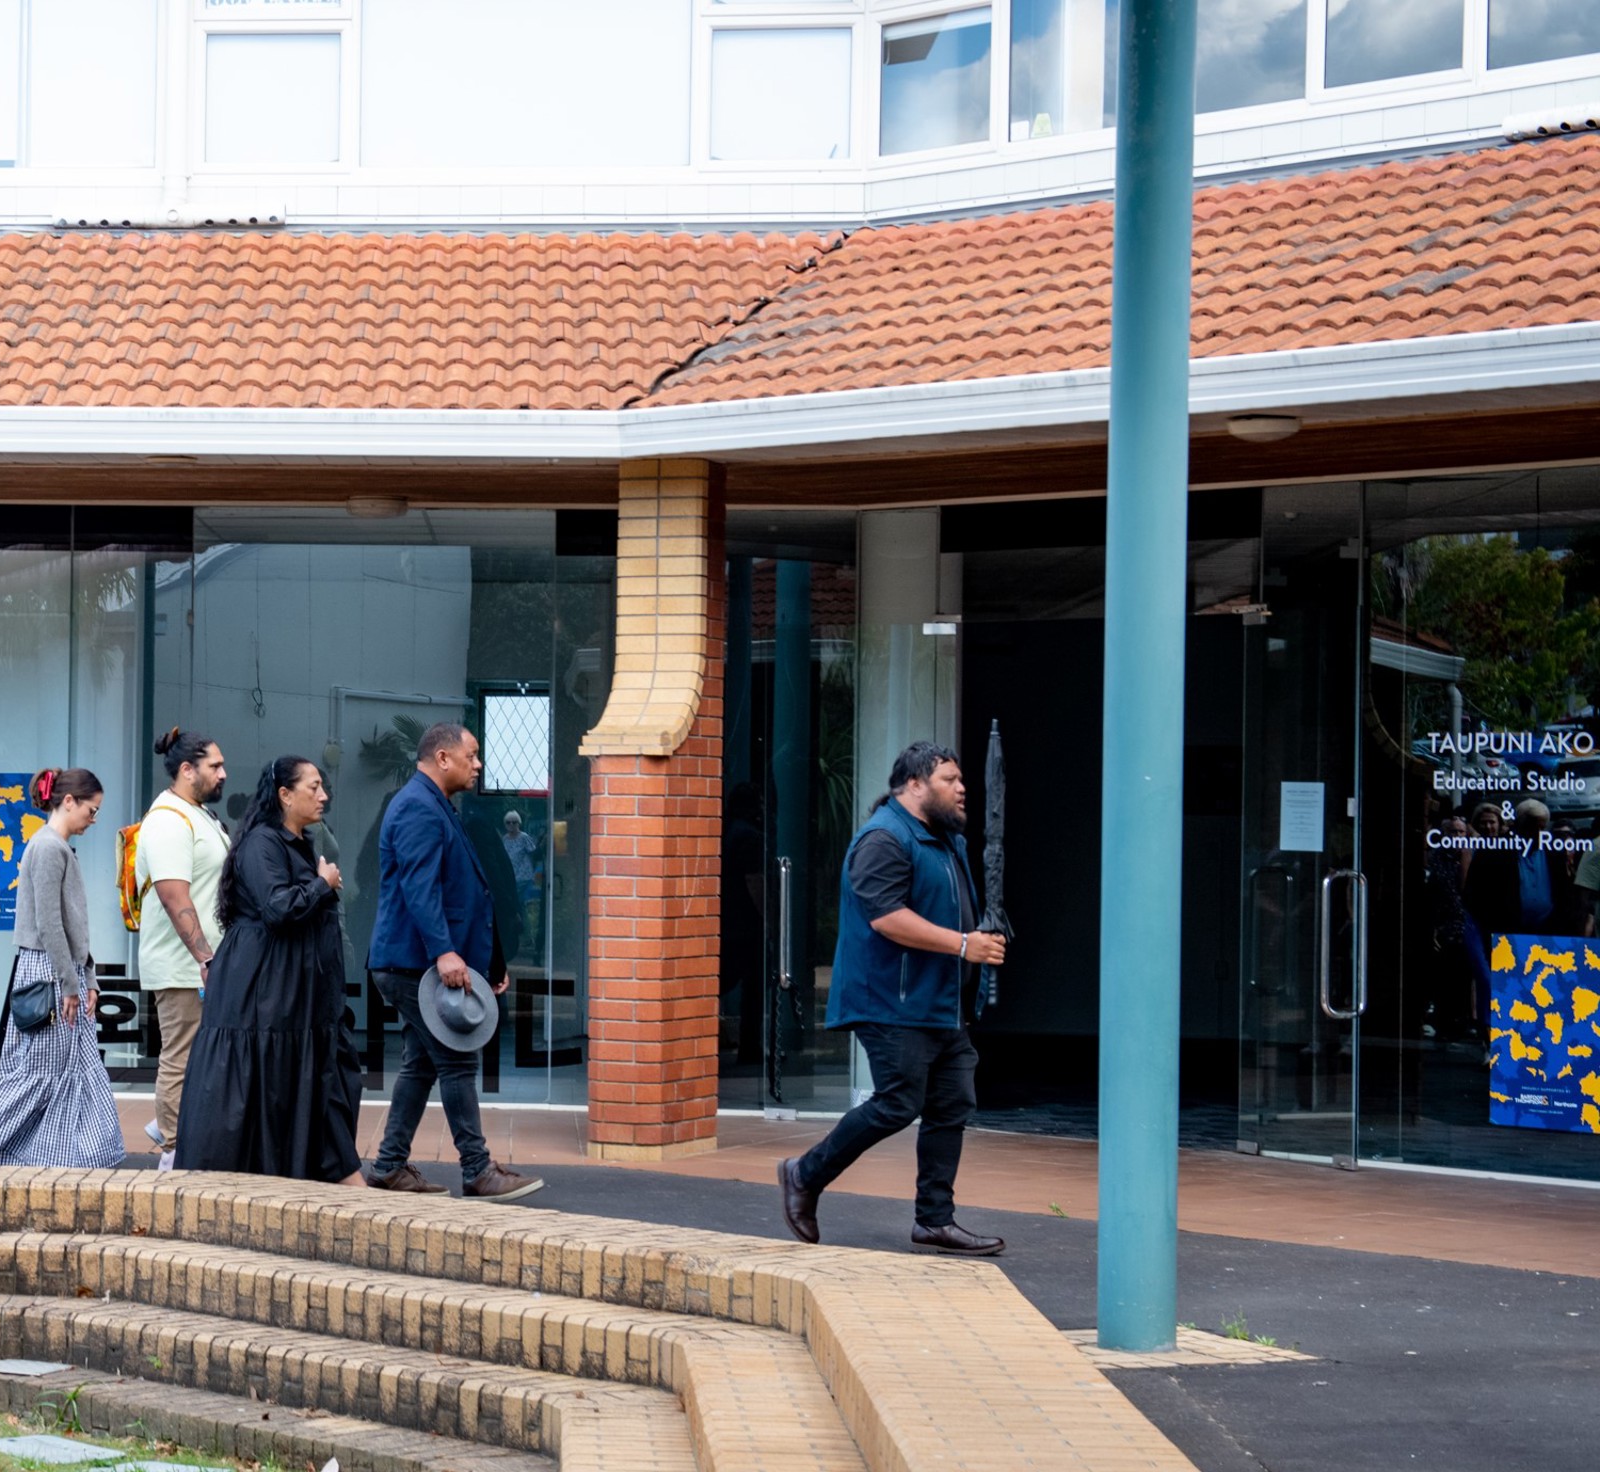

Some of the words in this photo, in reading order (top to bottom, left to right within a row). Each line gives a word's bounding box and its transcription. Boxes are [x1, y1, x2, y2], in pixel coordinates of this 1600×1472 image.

[1427, 732, 1533, 754] TAUPUNI
[1539, 732, 1595, 754] AKO
[1433, 771, 1521, 791] Education
[1527, 771, 1586, 791] Studio
[1500, 800, 1516, 821] &
[1426, 829, 1533, 858] Community
[1538, 831, 1593, 852] Room
